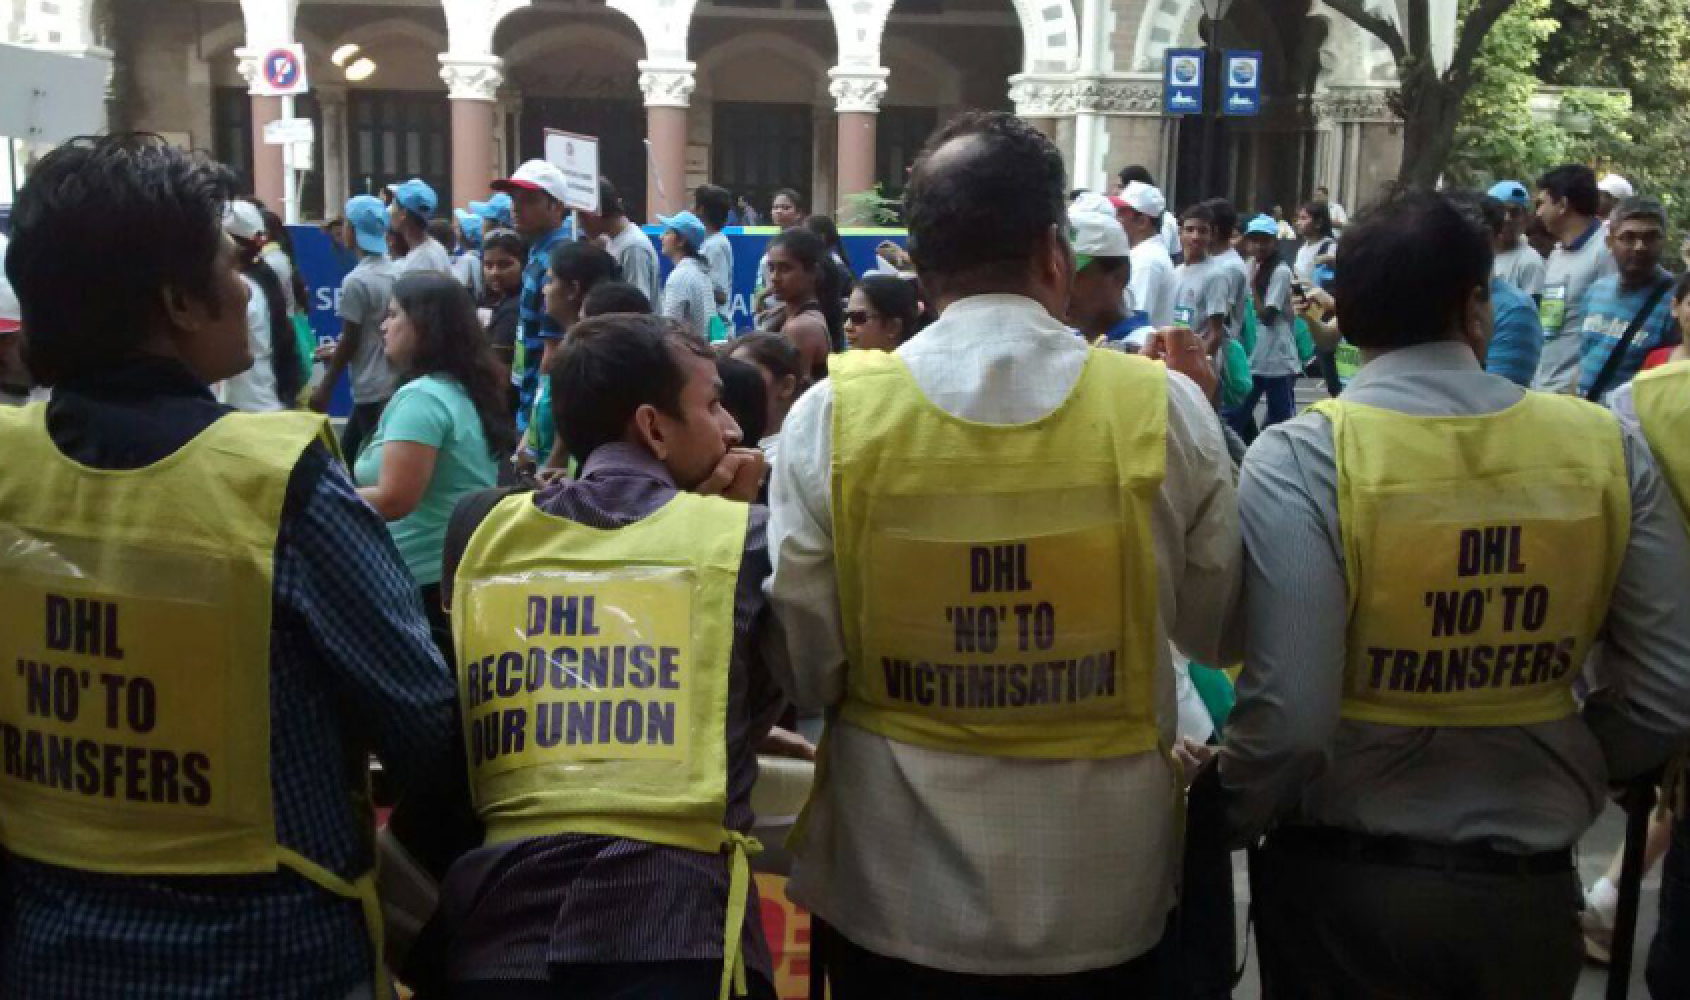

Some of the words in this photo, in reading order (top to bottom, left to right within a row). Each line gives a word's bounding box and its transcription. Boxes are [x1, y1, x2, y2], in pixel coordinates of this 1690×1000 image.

[970, 543, 1033, 593] DHL
[1457, 526, 1527, 577] DHL
[45, 593, 125, 660] DHL
[526, 595, 600, 637] DHL
[945, 605, 1007, 653] 'NO'
[1013, 601, 1055, 651] TO
[1424, 588, 1493, 637] 'NO'
[1501, 584, 1549, 633] TO
[467, 645, 680, 708] RECOGNISE
[881, 650, 1117, 709] VICTIMISATION
[1366, 636, 1577, 694] TRANSFERS
[16, 659, 91, 723] 'NO'
[99, 672, 157, 735] TO
[472, 708, 527, 768] OUR
[536, 699, 676, 749] UNION
[0, 719, 212, 807] RANSFERS
